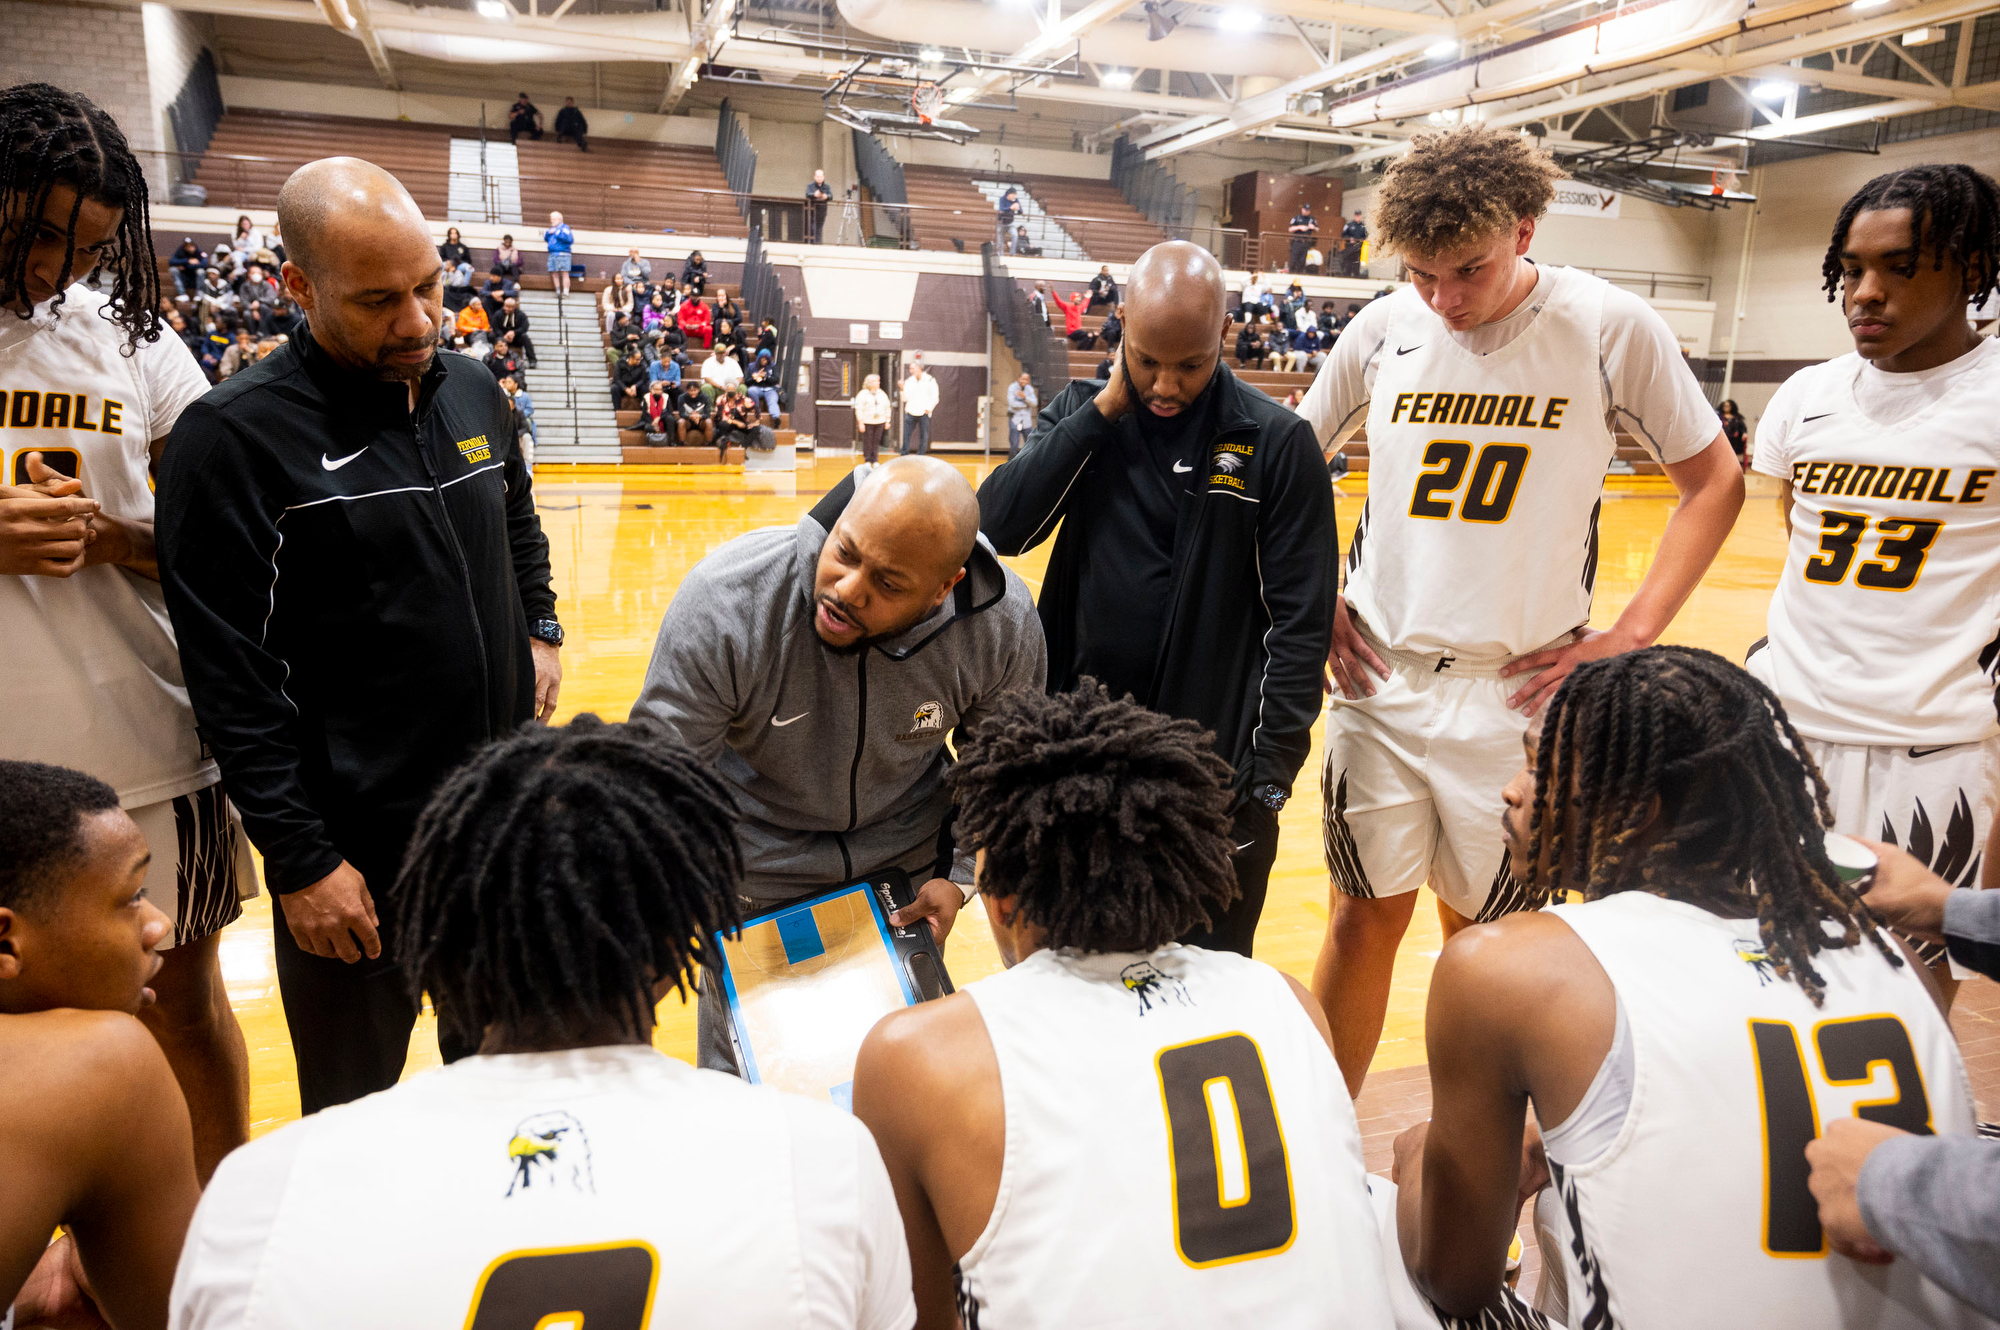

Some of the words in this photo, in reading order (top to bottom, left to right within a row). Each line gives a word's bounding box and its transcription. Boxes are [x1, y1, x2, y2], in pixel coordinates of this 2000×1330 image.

[0, 389, 123, 436] DALE
[1391, 392, 1570, 430] FERNDALE
[1213, 443, 1254, 456] ERNDALE
[1209, 474, 1245, 490] SKETBALL
[1408, 439, 1532, 525] 20
[1790, 461, 1998, 504] FERNDALE
[1803, 509, 1947, 593] 33
[1434, 656, 1456, 673] F
[1153, 1030, 1299, 1270] 0
